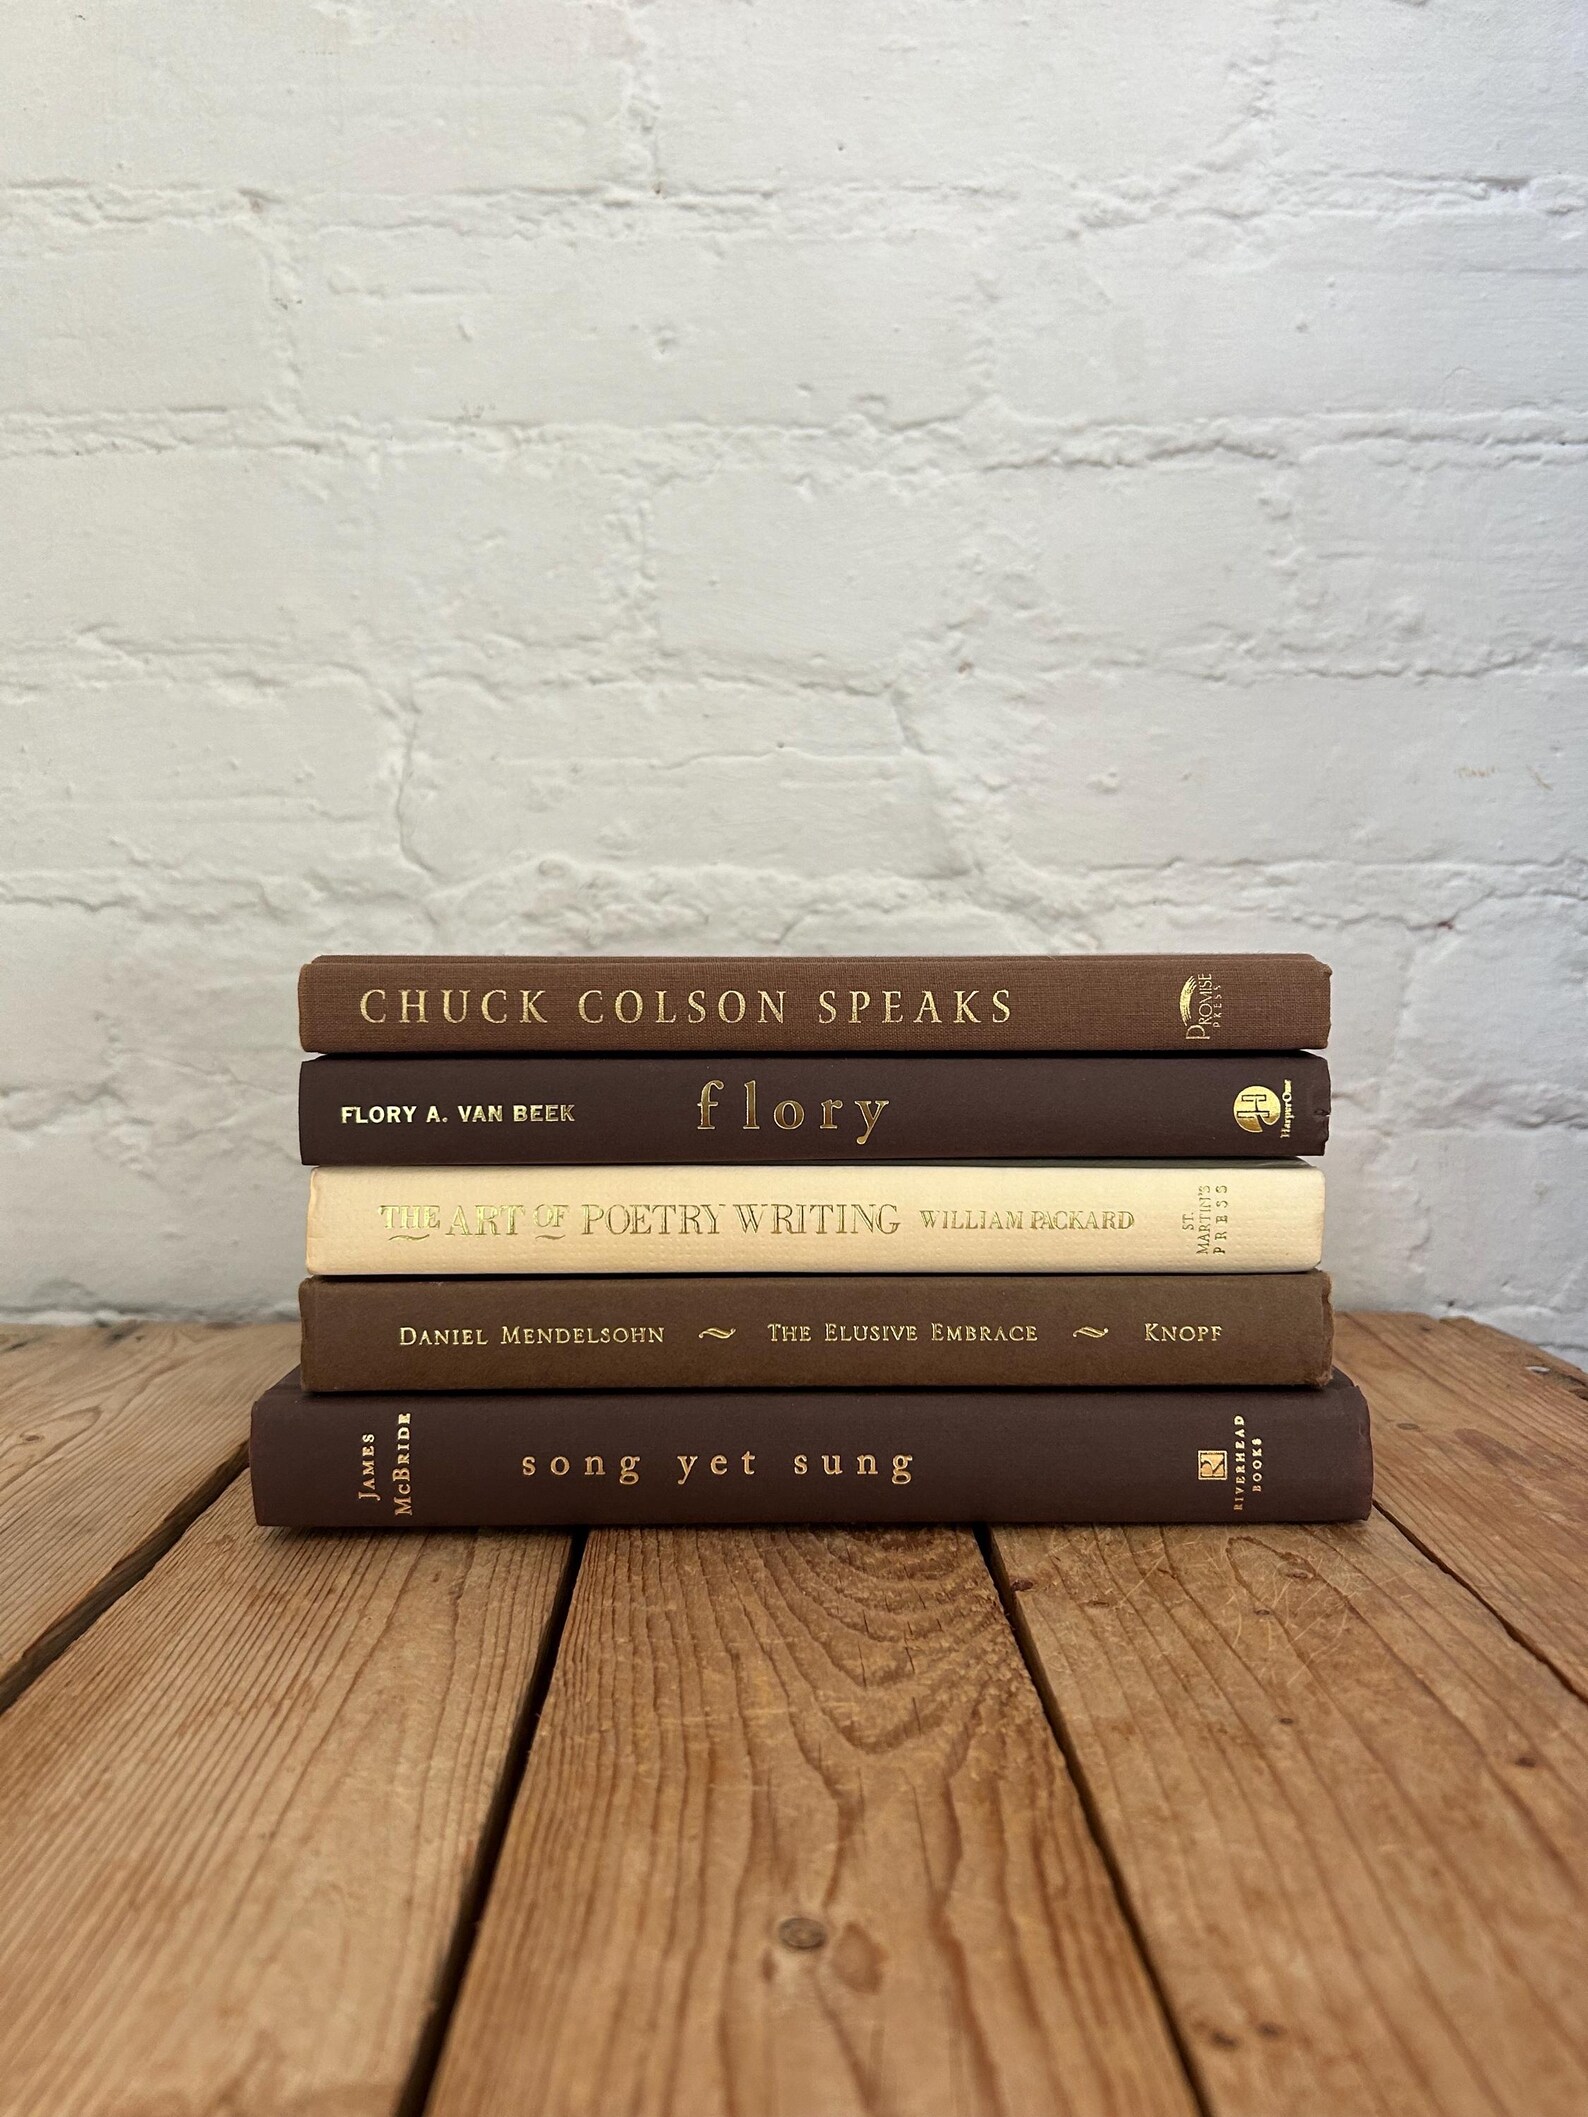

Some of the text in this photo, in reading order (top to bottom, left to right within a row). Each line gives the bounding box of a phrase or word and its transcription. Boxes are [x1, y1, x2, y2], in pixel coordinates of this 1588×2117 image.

[359, 989, 1012, 1025] CHUCK COLSON SPEAKS
[1185, 973, 1213, 1039] PROMISE
[1212, 985, 1222, 1028] PRESS
[341, 1104, 576, 1124] FLORY A. VAN BEEK
[696, 1079, 890, 1145] flory
[378, 1203, 1135, 1236] THE ART OF POETRY WRITING WILLIAM PACKARD
[1181, 1212, 1194, 1231] ST.
[1196, 1185, 1211, 1255] MARTIN'S
[1213, 1185, 1228, 1254] PRESS
[399, 1325, 665, 1347] DANIEL MENDELSOHN
[767, 1322, 1038, 1342] THE ELUSIVE EMBRACE
[1144, 1322, 1223, 1342] KNOPF
[358, 1433, 381, 1501] JAMES
[521, 1449, 913, 1486] song yet sung
[1233, 1415, 1246, 1511] RIVERHEAD
[1251, 1438, 1263, 1492] BOOKS
